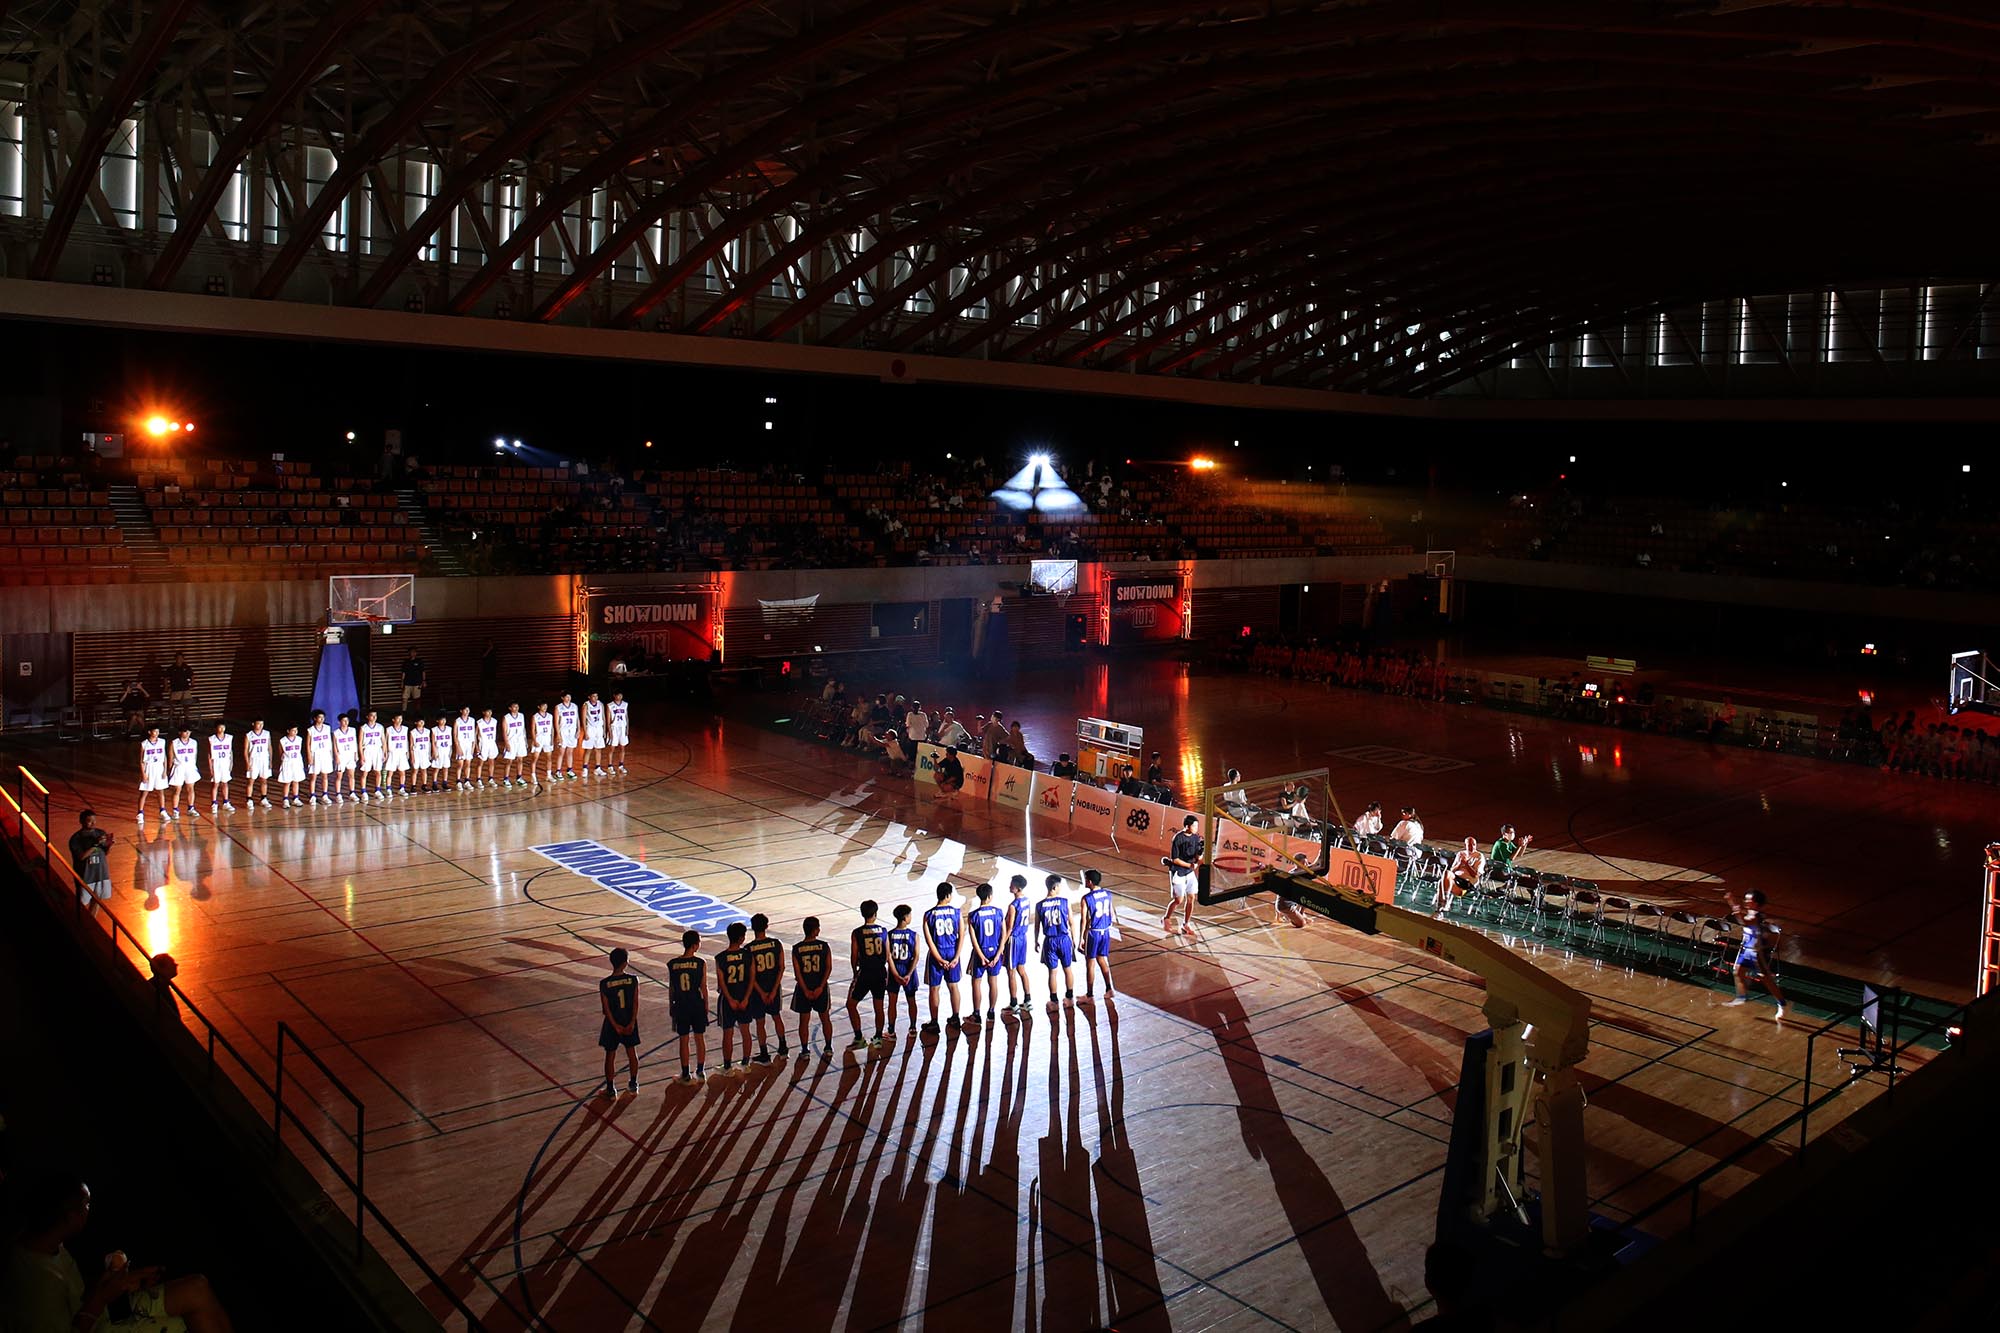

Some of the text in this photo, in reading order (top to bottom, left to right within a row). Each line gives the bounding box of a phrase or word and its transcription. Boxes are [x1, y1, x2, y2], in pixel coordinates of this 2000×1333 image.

[1116, 584, 1174, 601] SHOWDOWN
[603, 603, 697, 624] SHOWDOWN
[1307, 899, 1330, 915] Senoh
[984, 918, 994, 937] 0
[756, 951, 776, 972] 30
[727, 963, 745, 984] 21
[617, 988, 626, 1009] 1
